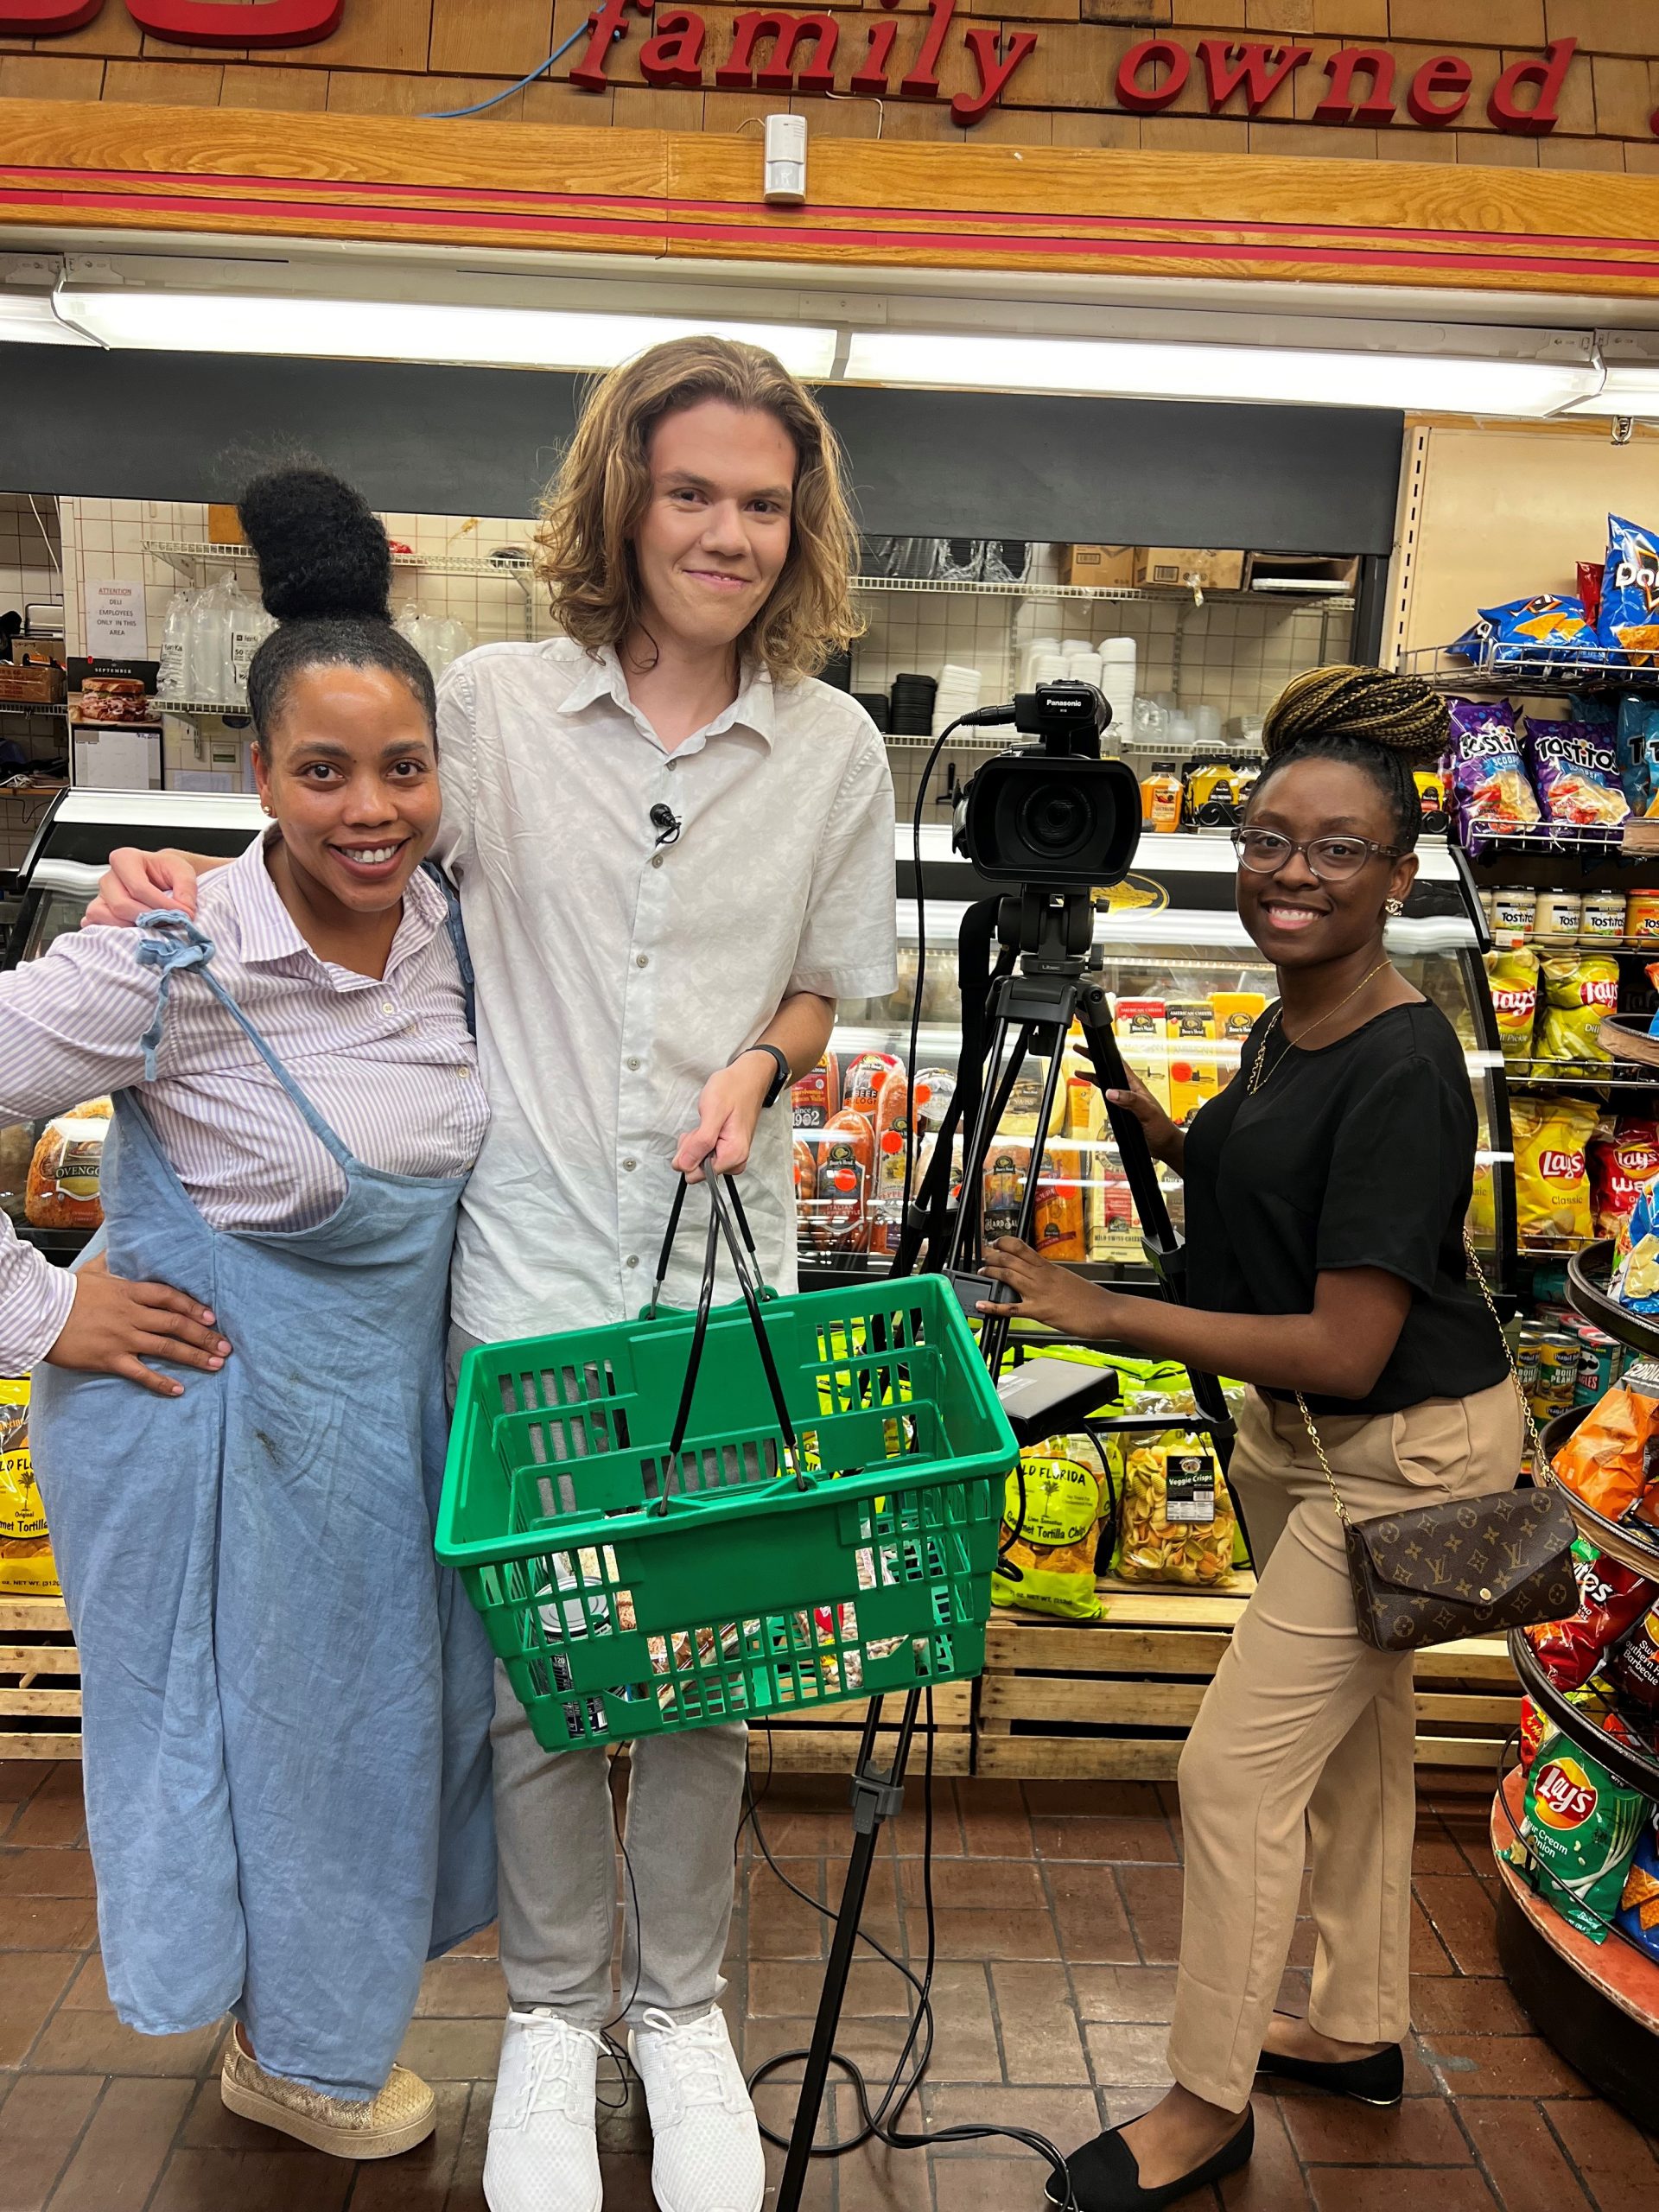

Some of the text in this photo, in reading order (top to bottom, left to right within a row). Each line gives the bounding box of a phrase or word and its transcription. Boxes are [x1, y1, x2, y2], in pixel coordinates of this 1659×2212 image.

[569, 0, 1577, 133] family owned
[1046, 698, 1082, 708] Panasonic
[792, 1110, 820, 1127] 1902
[1543, 1152, 1583, 1179] Lay's
[1618, 1152, 1657, 1171] Lay's
[1551, 1196, 1583, 1205] Classic
[1168, 1474, 1212, 1486] Veggie Crisps
[17, 1518, 48, 1532] Tortilla
[1040, 1517, 1063, 1526] Sensation
[1037, 1525, 1065, 1539] Tortilla
[1625, 1640, 1655, 1669] outhern
[1623, 1649, 1659, 1686] Barbecue
[1538, 1766, 1593, 1814] Lay's
[1538, 1829, 1568, 1855] Cream
